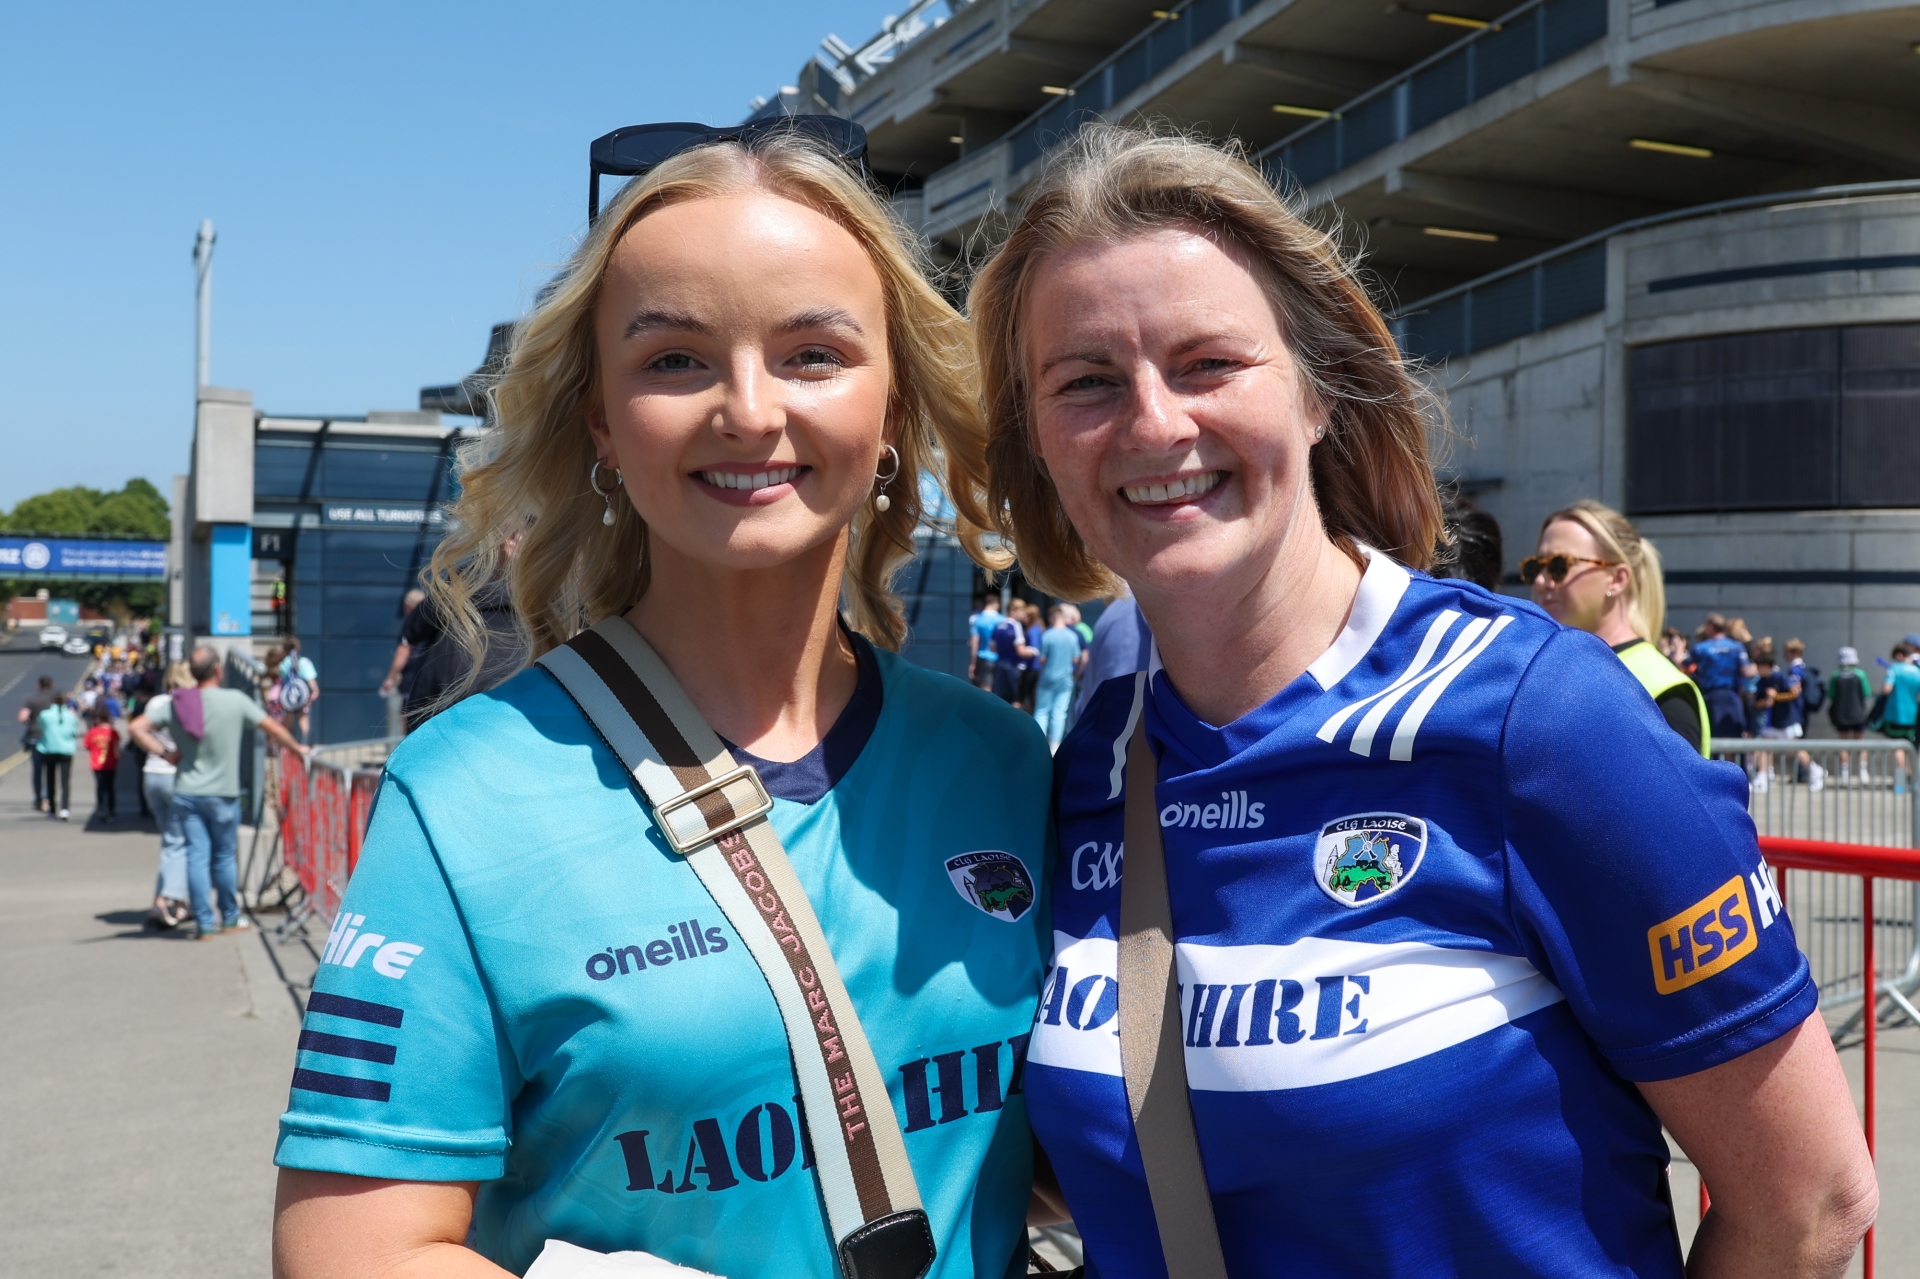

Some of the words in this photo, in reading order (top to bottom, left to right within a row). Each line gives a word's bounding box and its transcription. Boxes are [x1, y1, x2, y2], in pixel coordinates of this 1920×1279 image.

[260, 533, 281, 552] F1
[328, 508, 352, 521] USE
[353, 508, 376, 522] ALL
[1336, 820, 1358, 831] CLG
[718, 829, 801, 953] JACOBS
[320, 911, 424, 980] Hire
[1658, 892, 1749, 982] HSS
[799, 966, 844, 1064] MARC
[1186, 975, 1370, 1048] HIRE
[834, 1071, 865, 1142] THE
